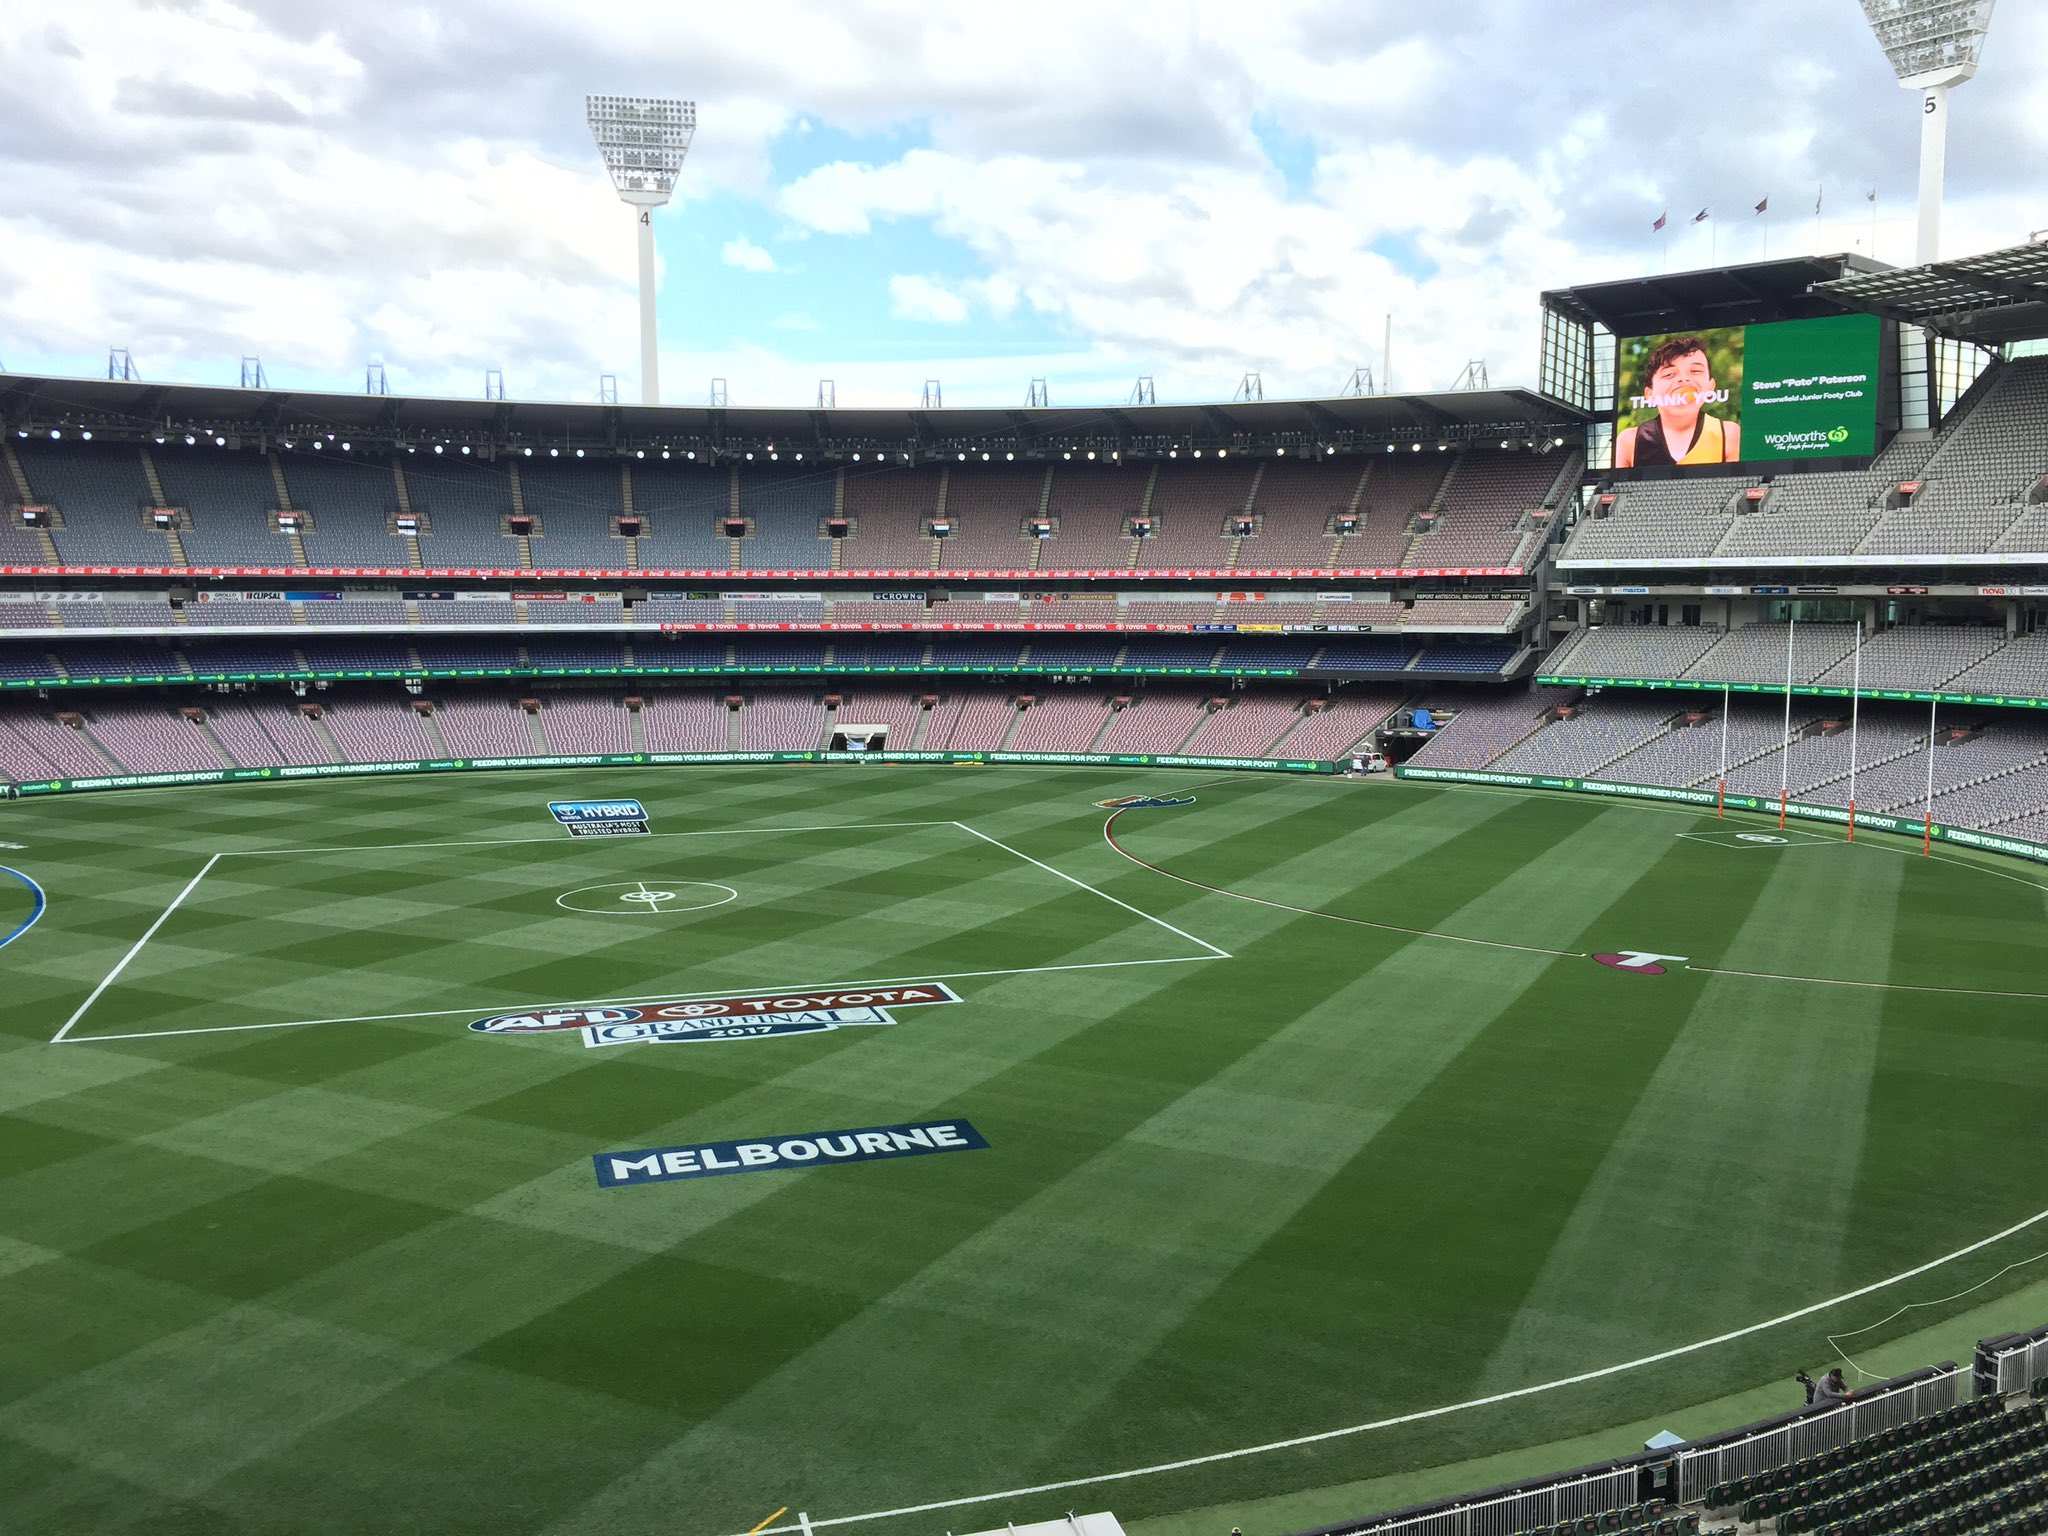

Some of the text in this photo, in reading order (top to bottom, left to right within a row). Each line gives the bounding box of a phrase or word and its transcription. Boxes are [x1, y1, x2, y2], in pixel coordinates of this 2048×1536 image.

[1924, 96, 1937, 114] 5
[640, 211, 650, 226] 4
[1752, 380, 1781, 390] Steve
[1819, 374, 1866, 385] Paterson
[1630, 389, 1729, 409] THANK YOU
[1800, 393, 1822, 401] Junior
[1823, 391, 1844, 400] Footy
[1845, 390, 1863, 398] Club
[750, 752, 774, 760] FOOTY
[854, 752, 873, 761] YOUR
[317, 765, 339, 773] YOUR
[1438, 770, 1457, 778] YOUR
[1490, 774, 1505, 782] FOR
[1506, 775, 1532, 783] FOOTY
[111, 776, 136, 785] YOUR
[176, 773, 193, 781] FOR
[195, 771, 223, 780] FOOTY
[1616, 785, 1637, 793] YOUR
[1672, 790, 1687, 798] FOR
[1688, 792, 1714, 801] FOOTY
[580, 804, 640, 817] HYBRID
[1765, 801, 1896, 827] FEEING YOUR HUNGE FOR FOOTY
[1981, 836, 2001, 847] YOUR
[742, 990, 934, 1011] TOYOTA
[484, 1010, 629, 1032] AFL
[602, 1007, 872, 1038] GRAND FINAL
[709, 1026, 772, 1038] 2017
[610, 1125, 968, 1180] MELBOURNE
